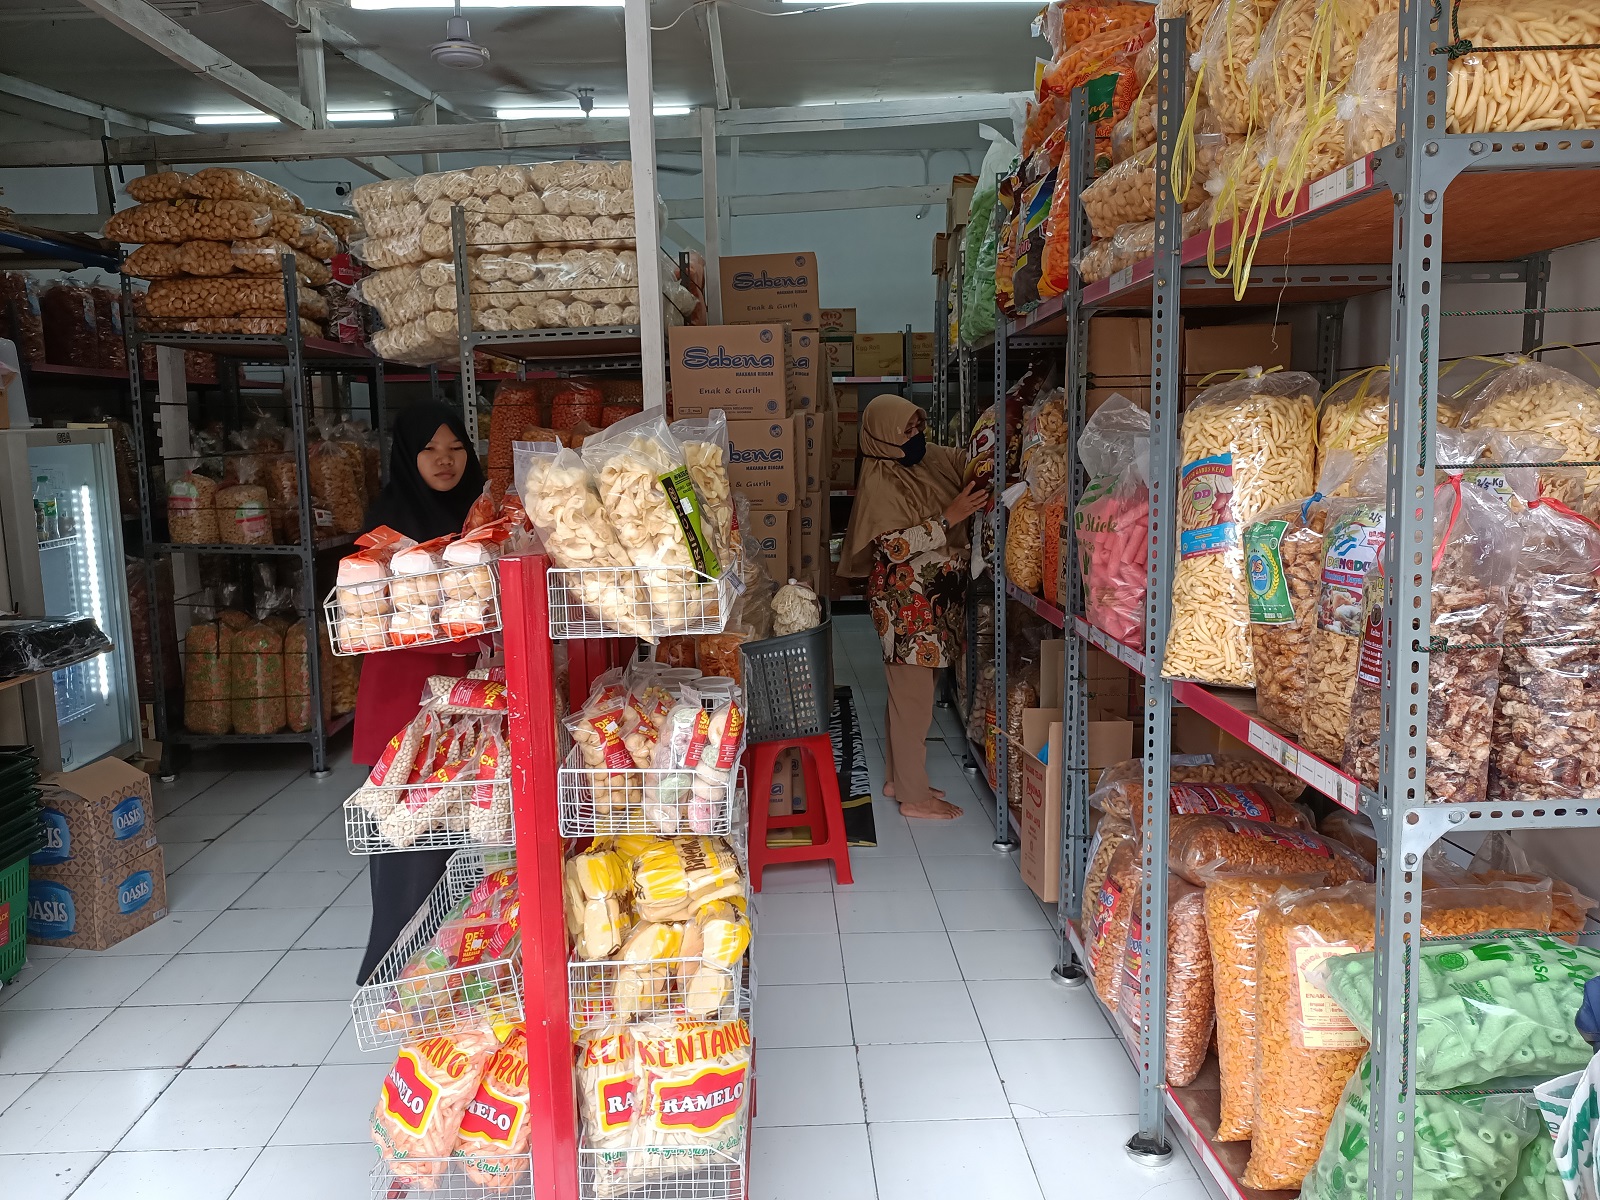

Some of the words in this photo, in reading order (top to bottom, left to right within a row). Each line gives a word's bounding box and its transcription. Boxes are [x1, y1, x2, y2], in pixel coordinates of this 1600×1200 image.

[732, 269, 808, 292] Sabena
[777, 302, 798, 310] Gurih
[682, 345, 774, 369] Sabena
[735, 386, 761, 395] Gurih
[729, 441, 783, 463] bena
[746, 480, 771, 488] Gurih
[1085, 513, 1118, 533] Stick
[116, 806, 142, 830] OASIS
[122, 880, 149, 905] OASIS
[465, 931, 480, 943] DE
[663, 1081, 744, 1114] RAMELO
